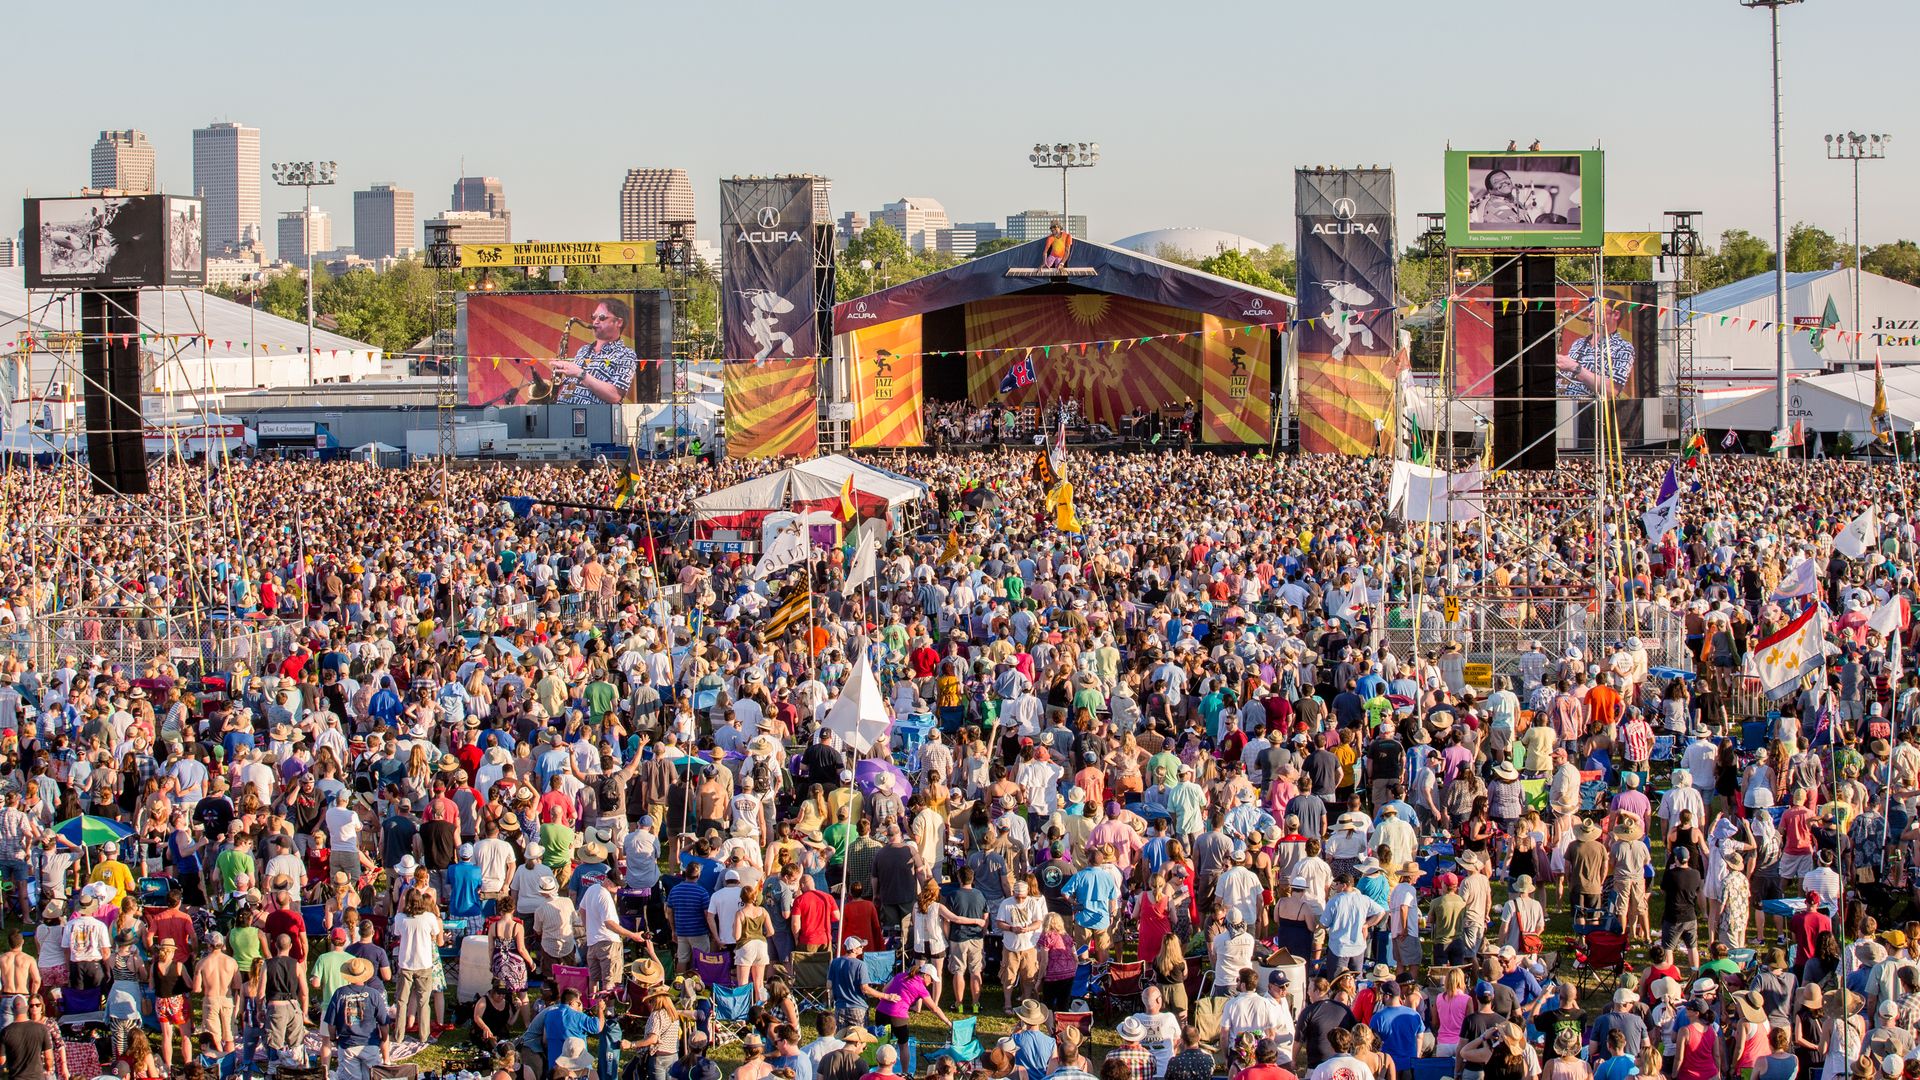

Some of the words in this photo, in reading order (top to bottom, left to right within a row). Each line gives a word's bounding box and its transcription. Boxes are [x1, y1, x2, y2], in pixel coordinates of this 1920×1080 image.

[1311, 223, 1379, 235] ACURA
[737, 231, 802, 243] ACURA
[513, 244, 531, 254] NEW
[534, 243, 571, 254] ORLEANS
[572, 243, 592, 254] JAZZ
[594, 243, 601, 252] &
[513, 254, 559, 265] HERITAGE
[562, 253, 601, 265] FESTIVAL
[1872, 316, 1919, 330] Jazz
[1872, 333, 1918, 347] Tent
[875, 378, 892, 387] JAZZ
[1231, 376, 1247, 385] JAZZ
[875, 389, 892, 398] FEST
[1231, 387, 1247, 396] FEST
[1787, 409, 1813, 417] CURA
[1446, 597, 1457, 608] M
[1448, 610, 1455, 621] 7
[699, 952, 724, 965] LSU
